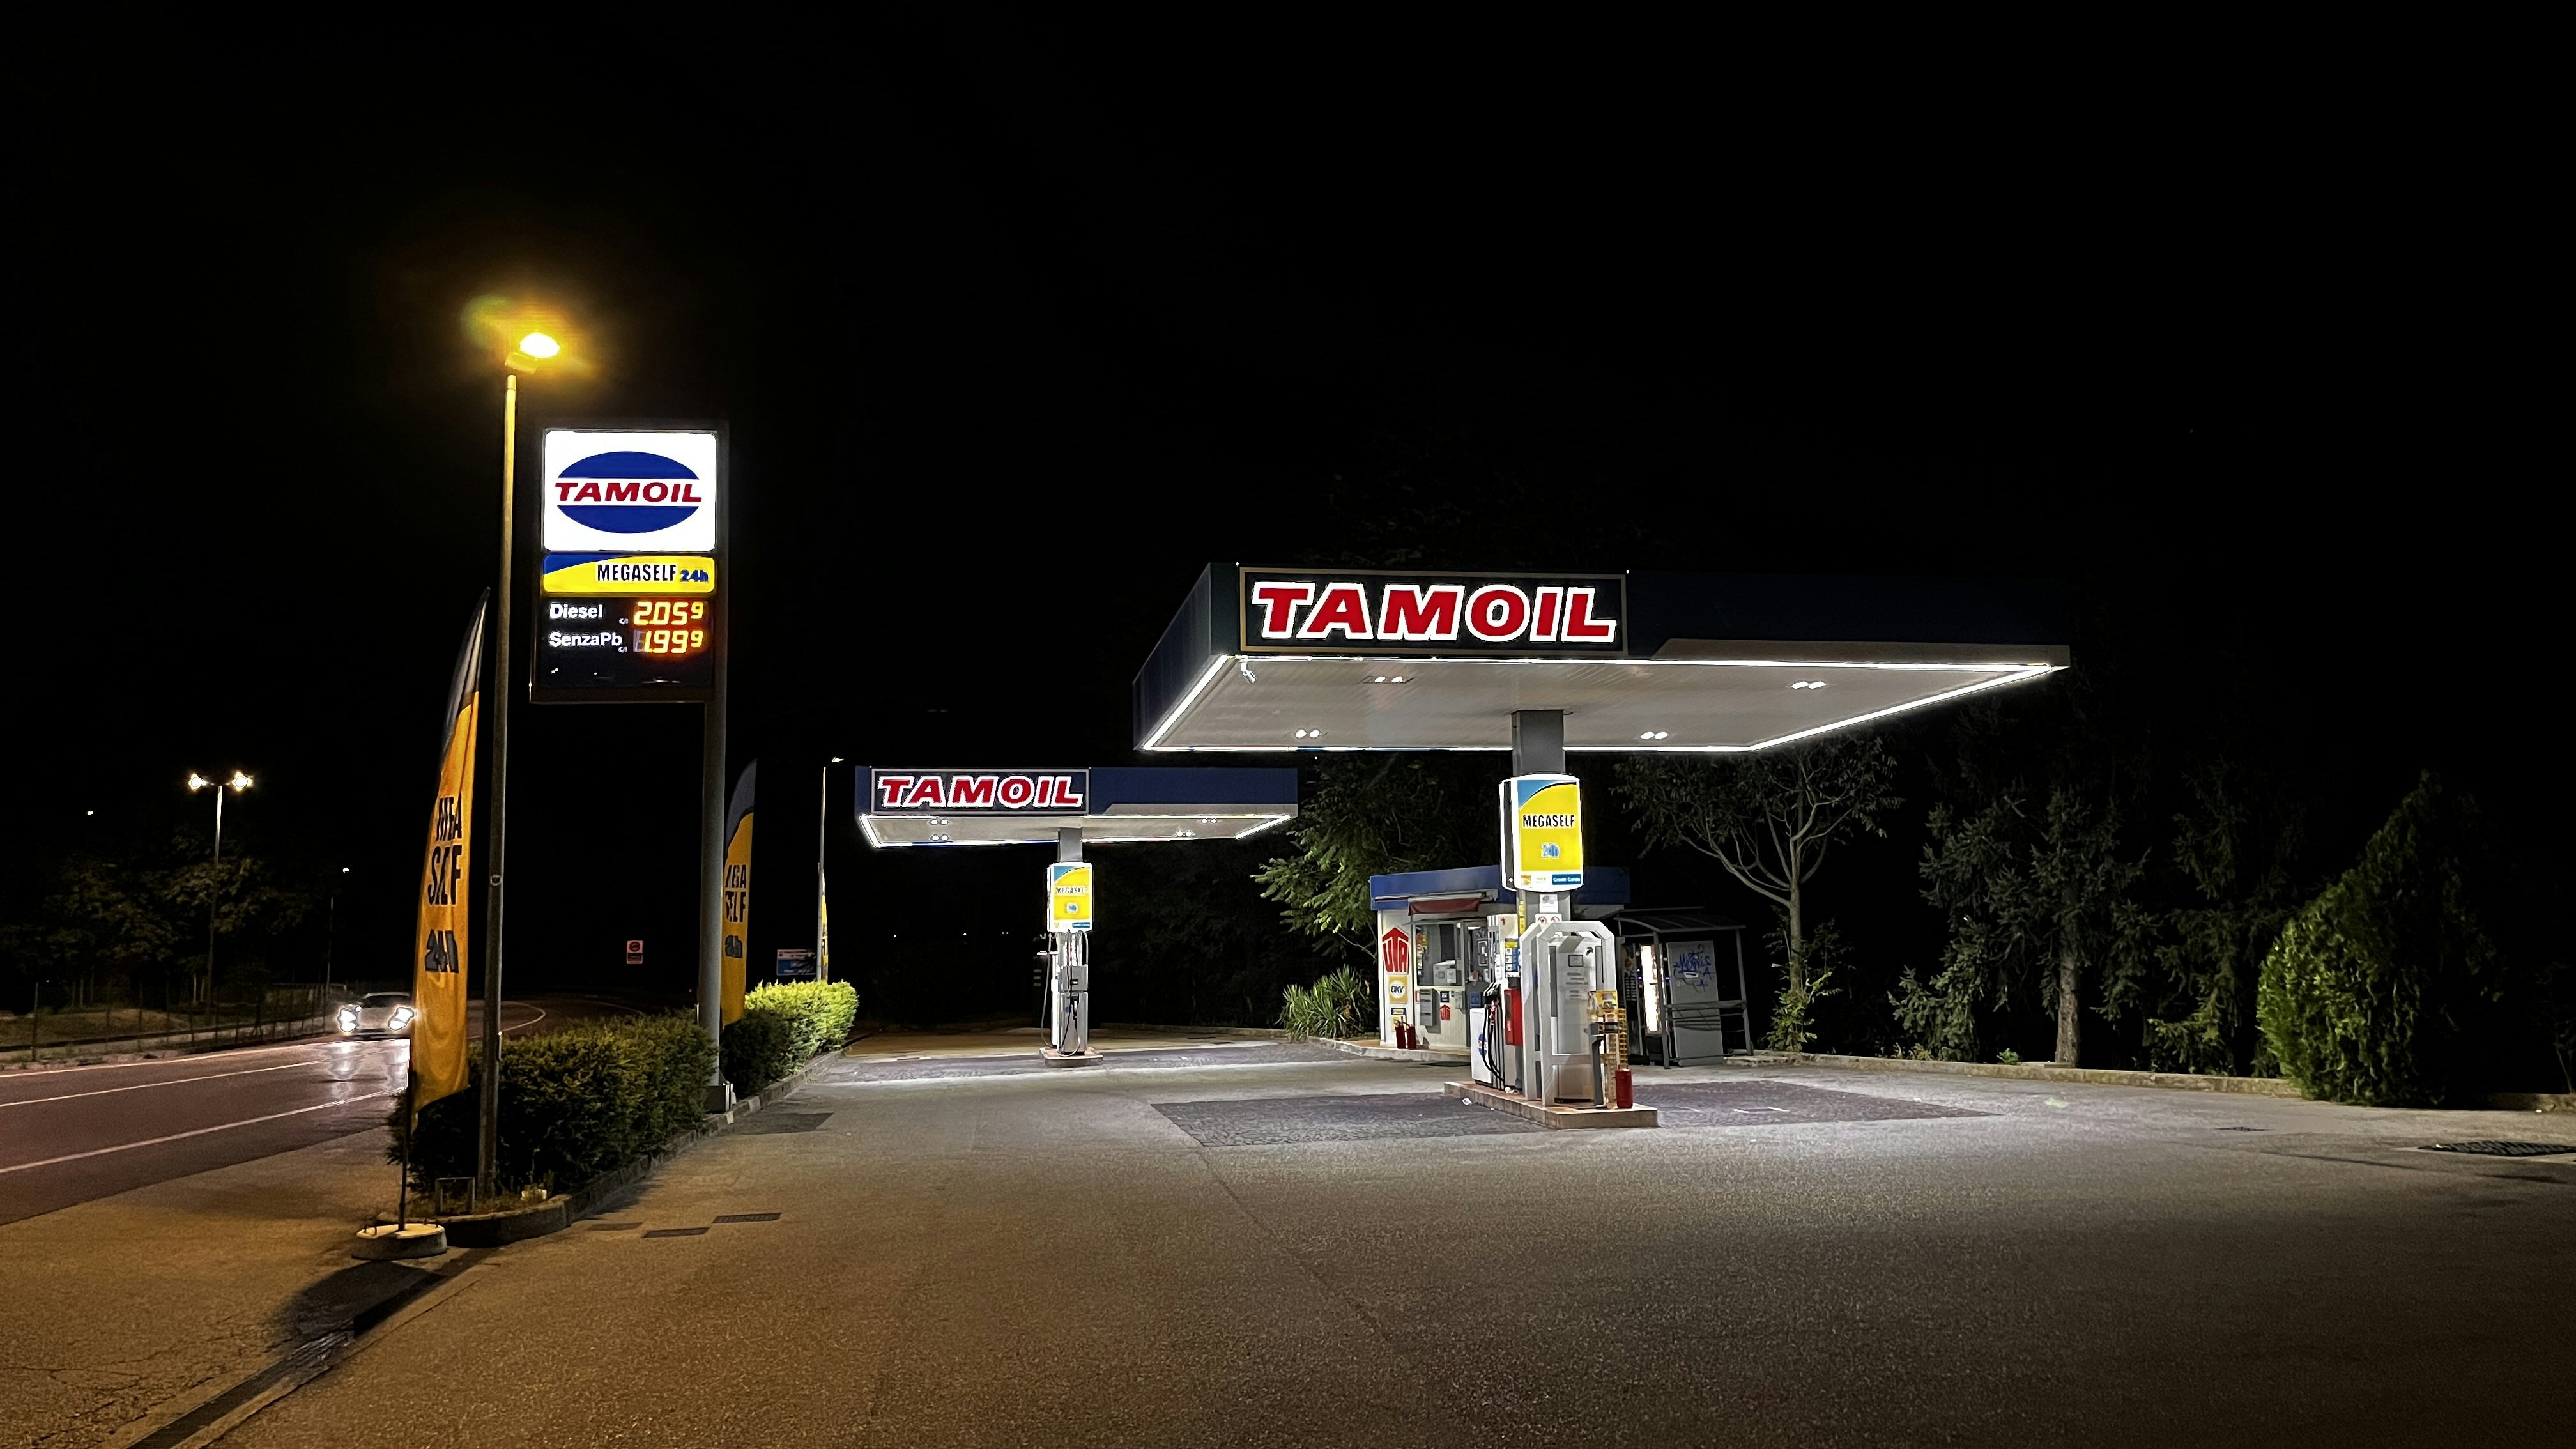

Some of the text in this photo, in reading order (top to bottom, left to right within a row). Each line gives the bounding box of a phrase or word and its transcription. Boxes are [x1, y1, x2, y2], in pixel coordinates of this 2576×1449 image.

[555, 482, 703, 503] TAMOIL
[597, 564, 709, 582] MEGASELF 24h
[549, 602, 603, 618] Diesel
[1252, 582, 1616, 642] TAMOIL
[549, 631, 622, 647] SenzaPb
[878, 776, 1084, 808] TAMOIL
[1523, 815, 1575, 827] MEGASELF
[1391, 985, 1404, 993] DKV
